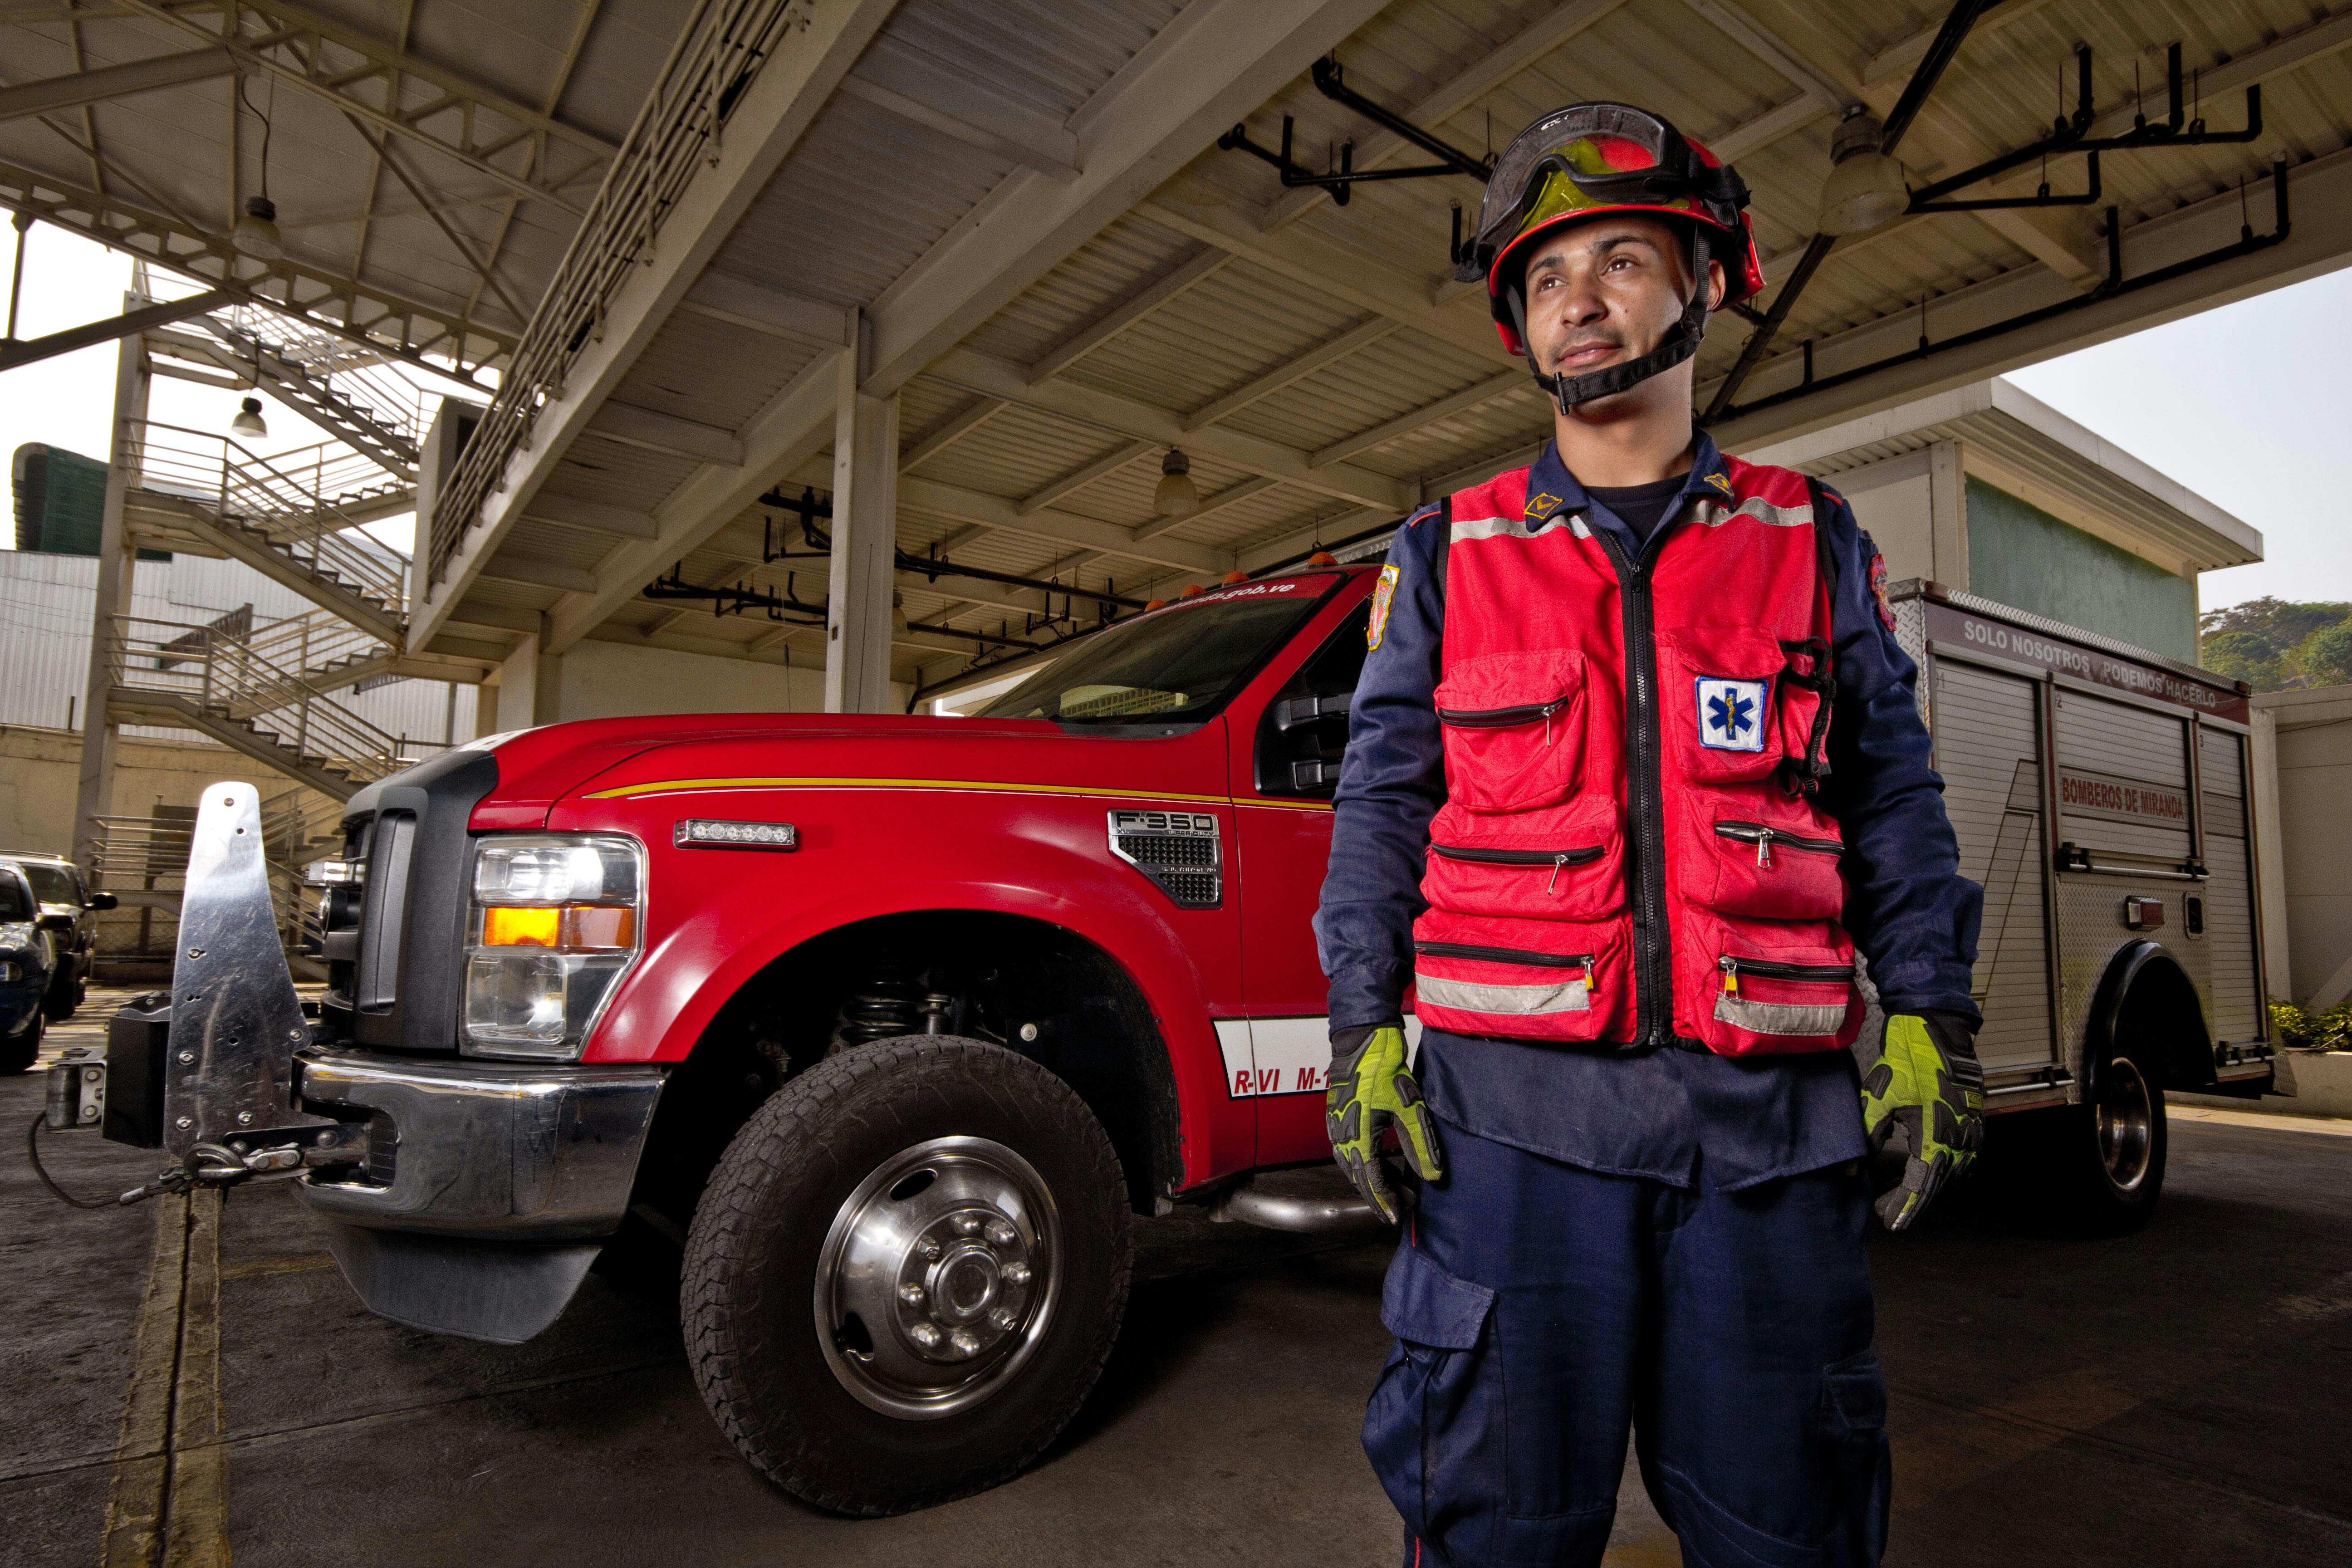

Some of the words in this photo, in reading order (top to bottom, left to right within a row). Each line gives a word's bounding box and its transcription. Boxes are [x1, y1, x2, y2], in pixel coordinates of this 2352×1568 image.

[1964, 620, 2007, 649] SOLO
[2012, 634, 2090, 673] NOSOTROS
[2103, 661, 2163, 694] PODEMOS
[2166, 680, 2216, 708] HACERLO
[2062, 777, 2122, 810] BOMBEROS
[2125, 787, 2139, 813] DE
[2141, 790, 2184, 819] MIRANDA
[1116, 812, 1214, 831] F-350
